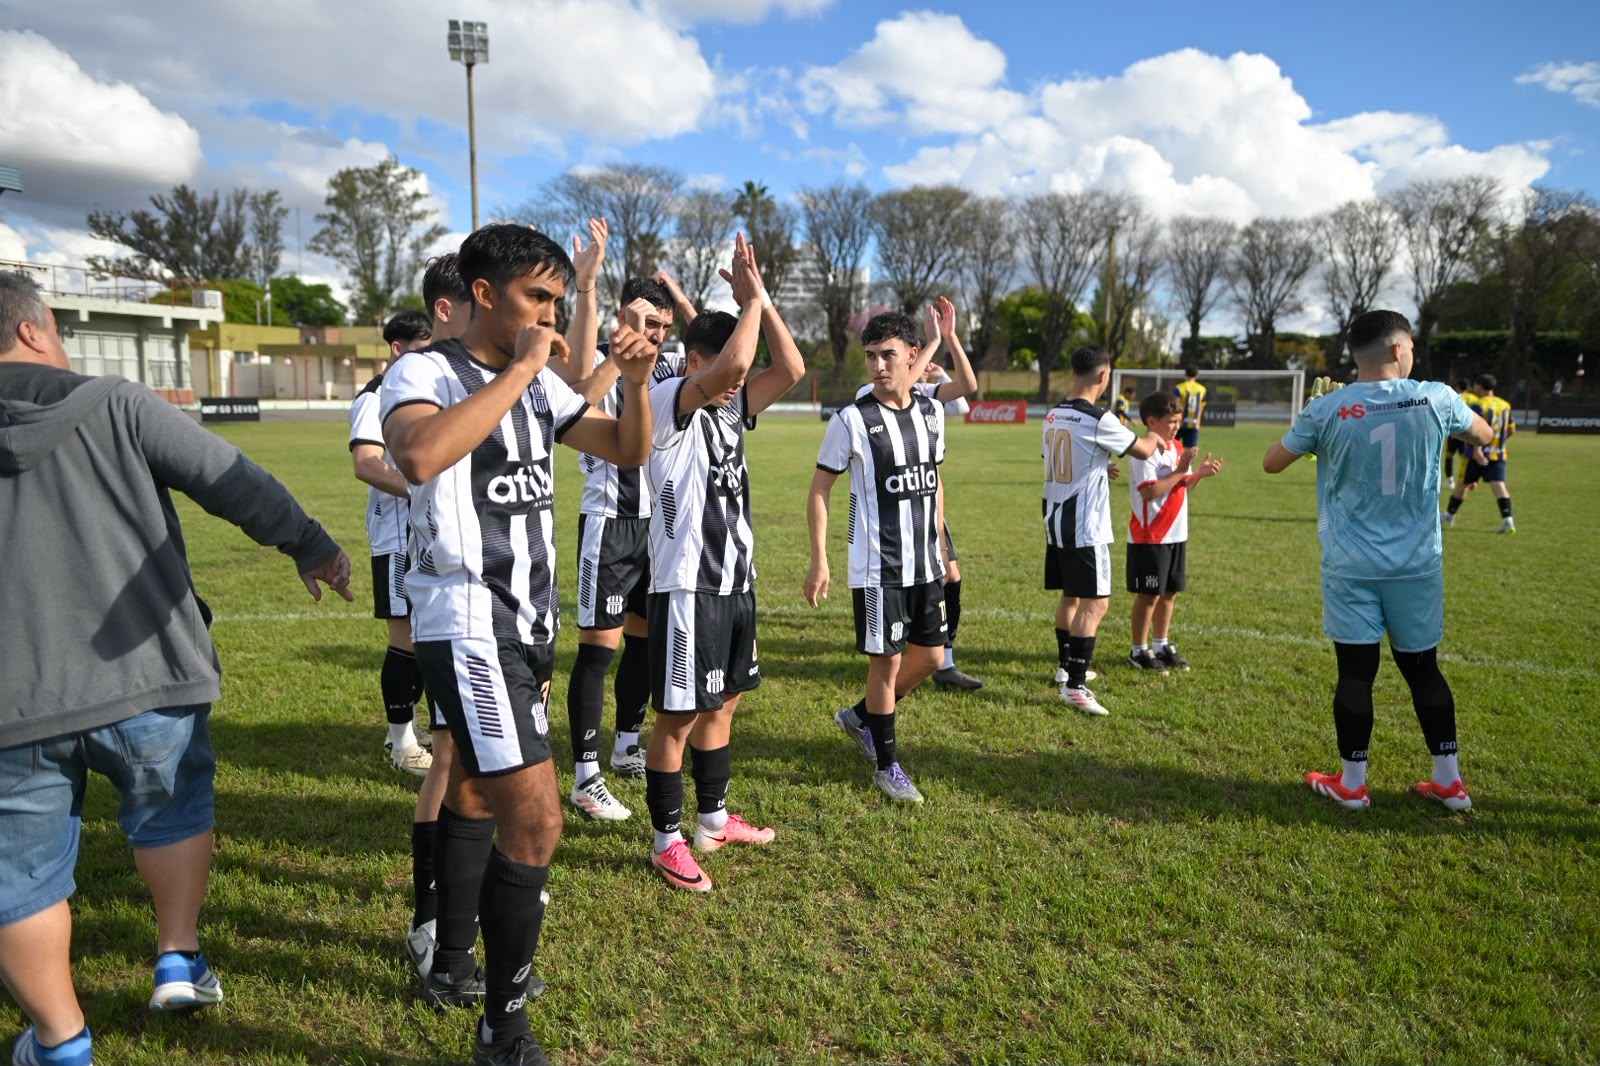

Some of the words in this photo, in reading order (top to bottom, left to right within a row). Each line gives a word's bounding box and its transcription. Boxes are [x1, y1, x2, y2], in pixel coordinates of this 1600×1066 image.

[1045, 428, 1073, 484] 10
[1370, 422, 1396, 496] 1
[885, 464, 937, 494] atila
[582, 751, 598, 760] GO
[1352, 751, 1368, 759] GO
[1439, 741, 1457, 751] GO
[505, 991, 527, 1013] GO
